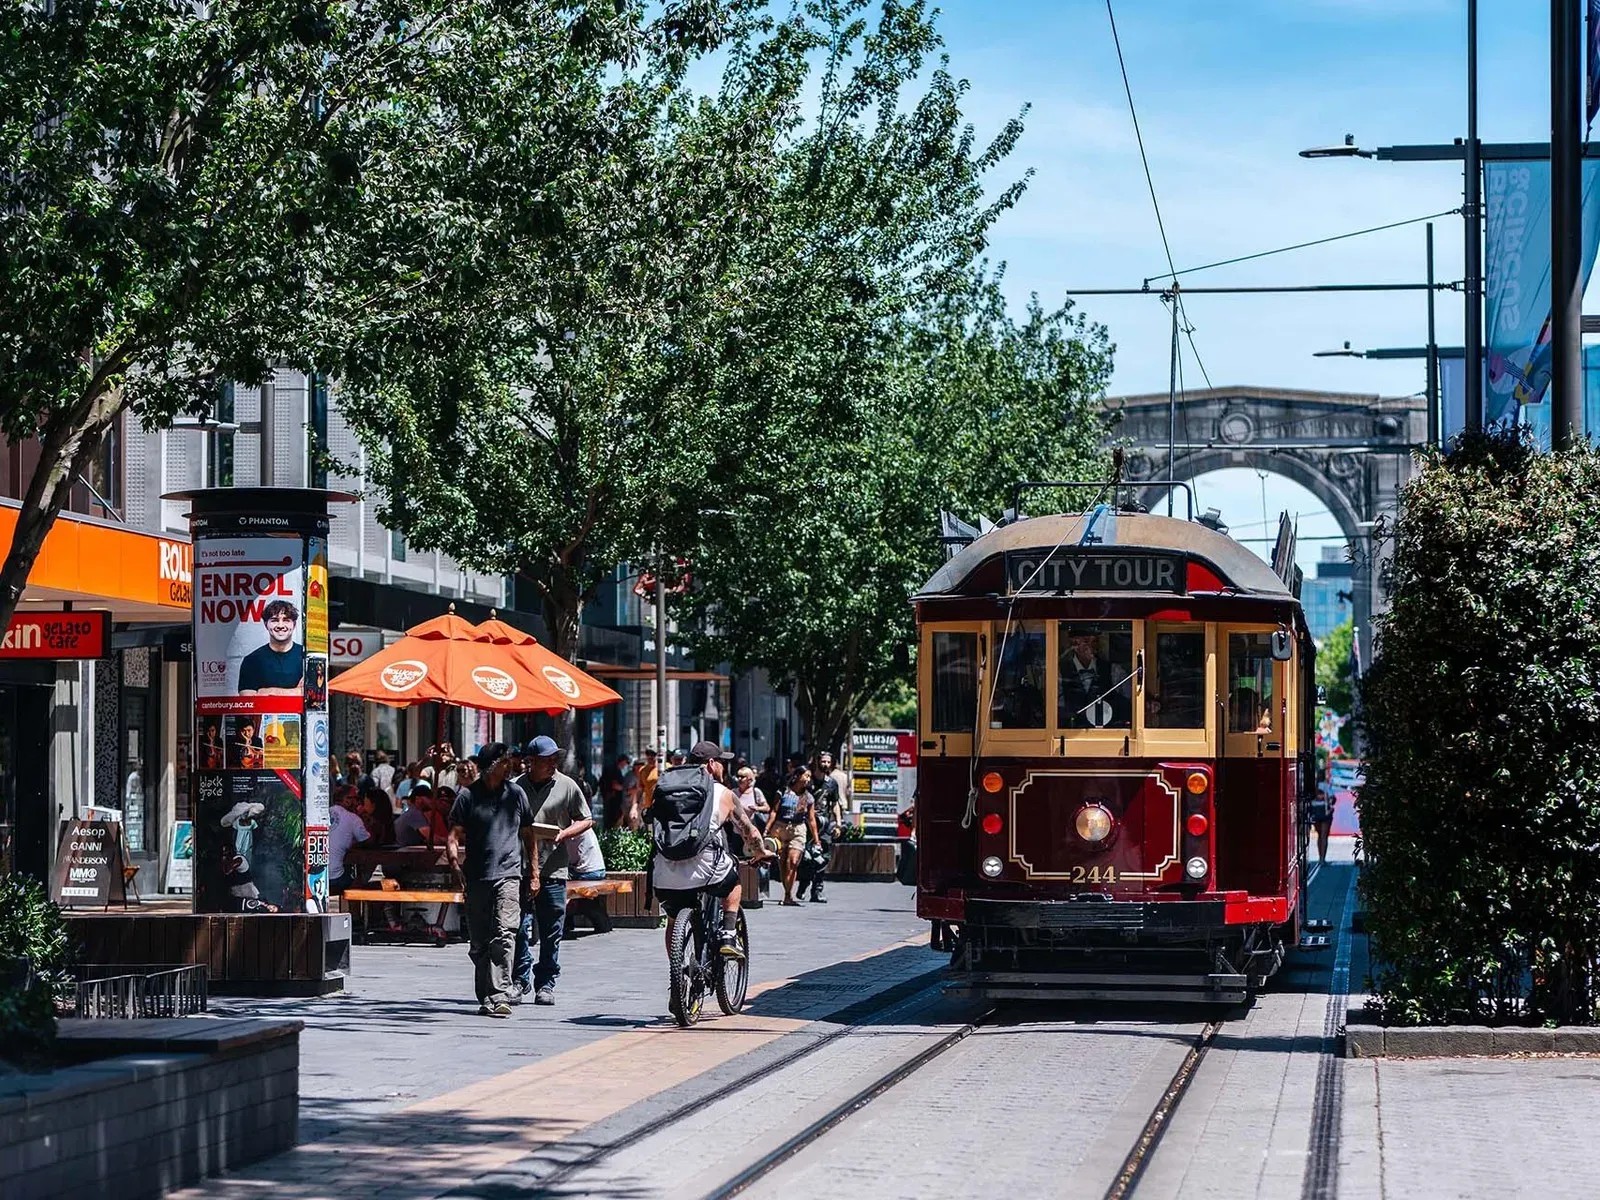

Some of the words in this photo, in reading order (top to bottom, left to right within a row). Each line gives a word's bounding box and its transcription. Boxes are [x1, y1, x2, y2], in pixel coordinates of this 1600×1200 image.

[232, 549, 246, 557] late
[1018, 559, 1088, 587] CITY
[1094, 559, 1175, 586] TOUR
[202, 572, 293, 597] ENROL
[202, 599, 266, 623] NOW
[202, 701, 254, 709] canterbury.ac.nz
[72, 826, 106, 838] Aesop
[70, 841, 103, 851] GANNI
[1072, 866, 1117, 883] 244
